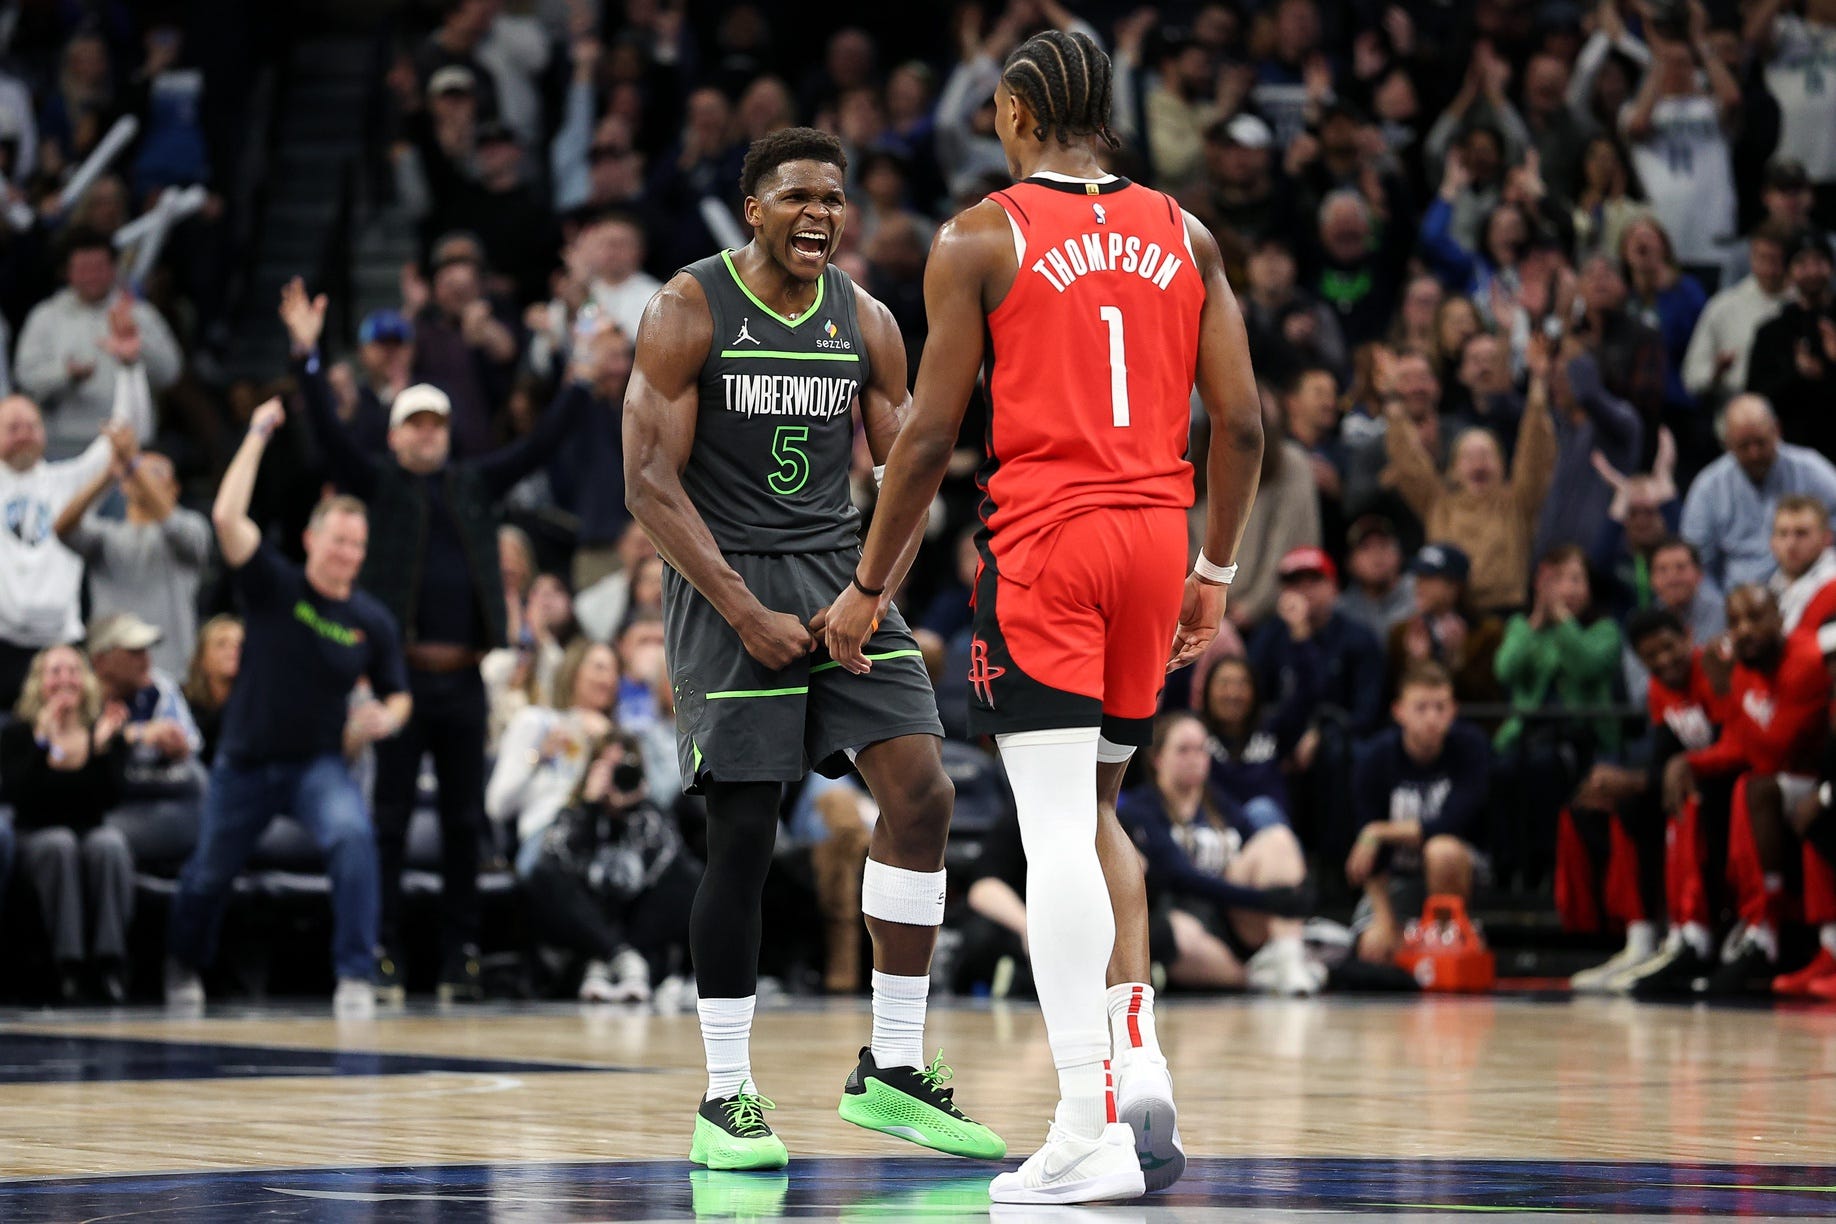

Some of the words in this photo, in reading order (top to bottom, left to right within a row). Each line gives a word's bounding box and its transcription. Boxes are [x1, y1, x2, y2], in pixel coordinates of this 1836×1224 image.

[1031, 232, 1183, 293] THOMPSON
[816, 337, 851, 350] sezzle
[1099, 305, 1131, 428] 1
[722, 374, 858, 422] TIMBERWOLVES
[767, 425, 810, 495] 5
